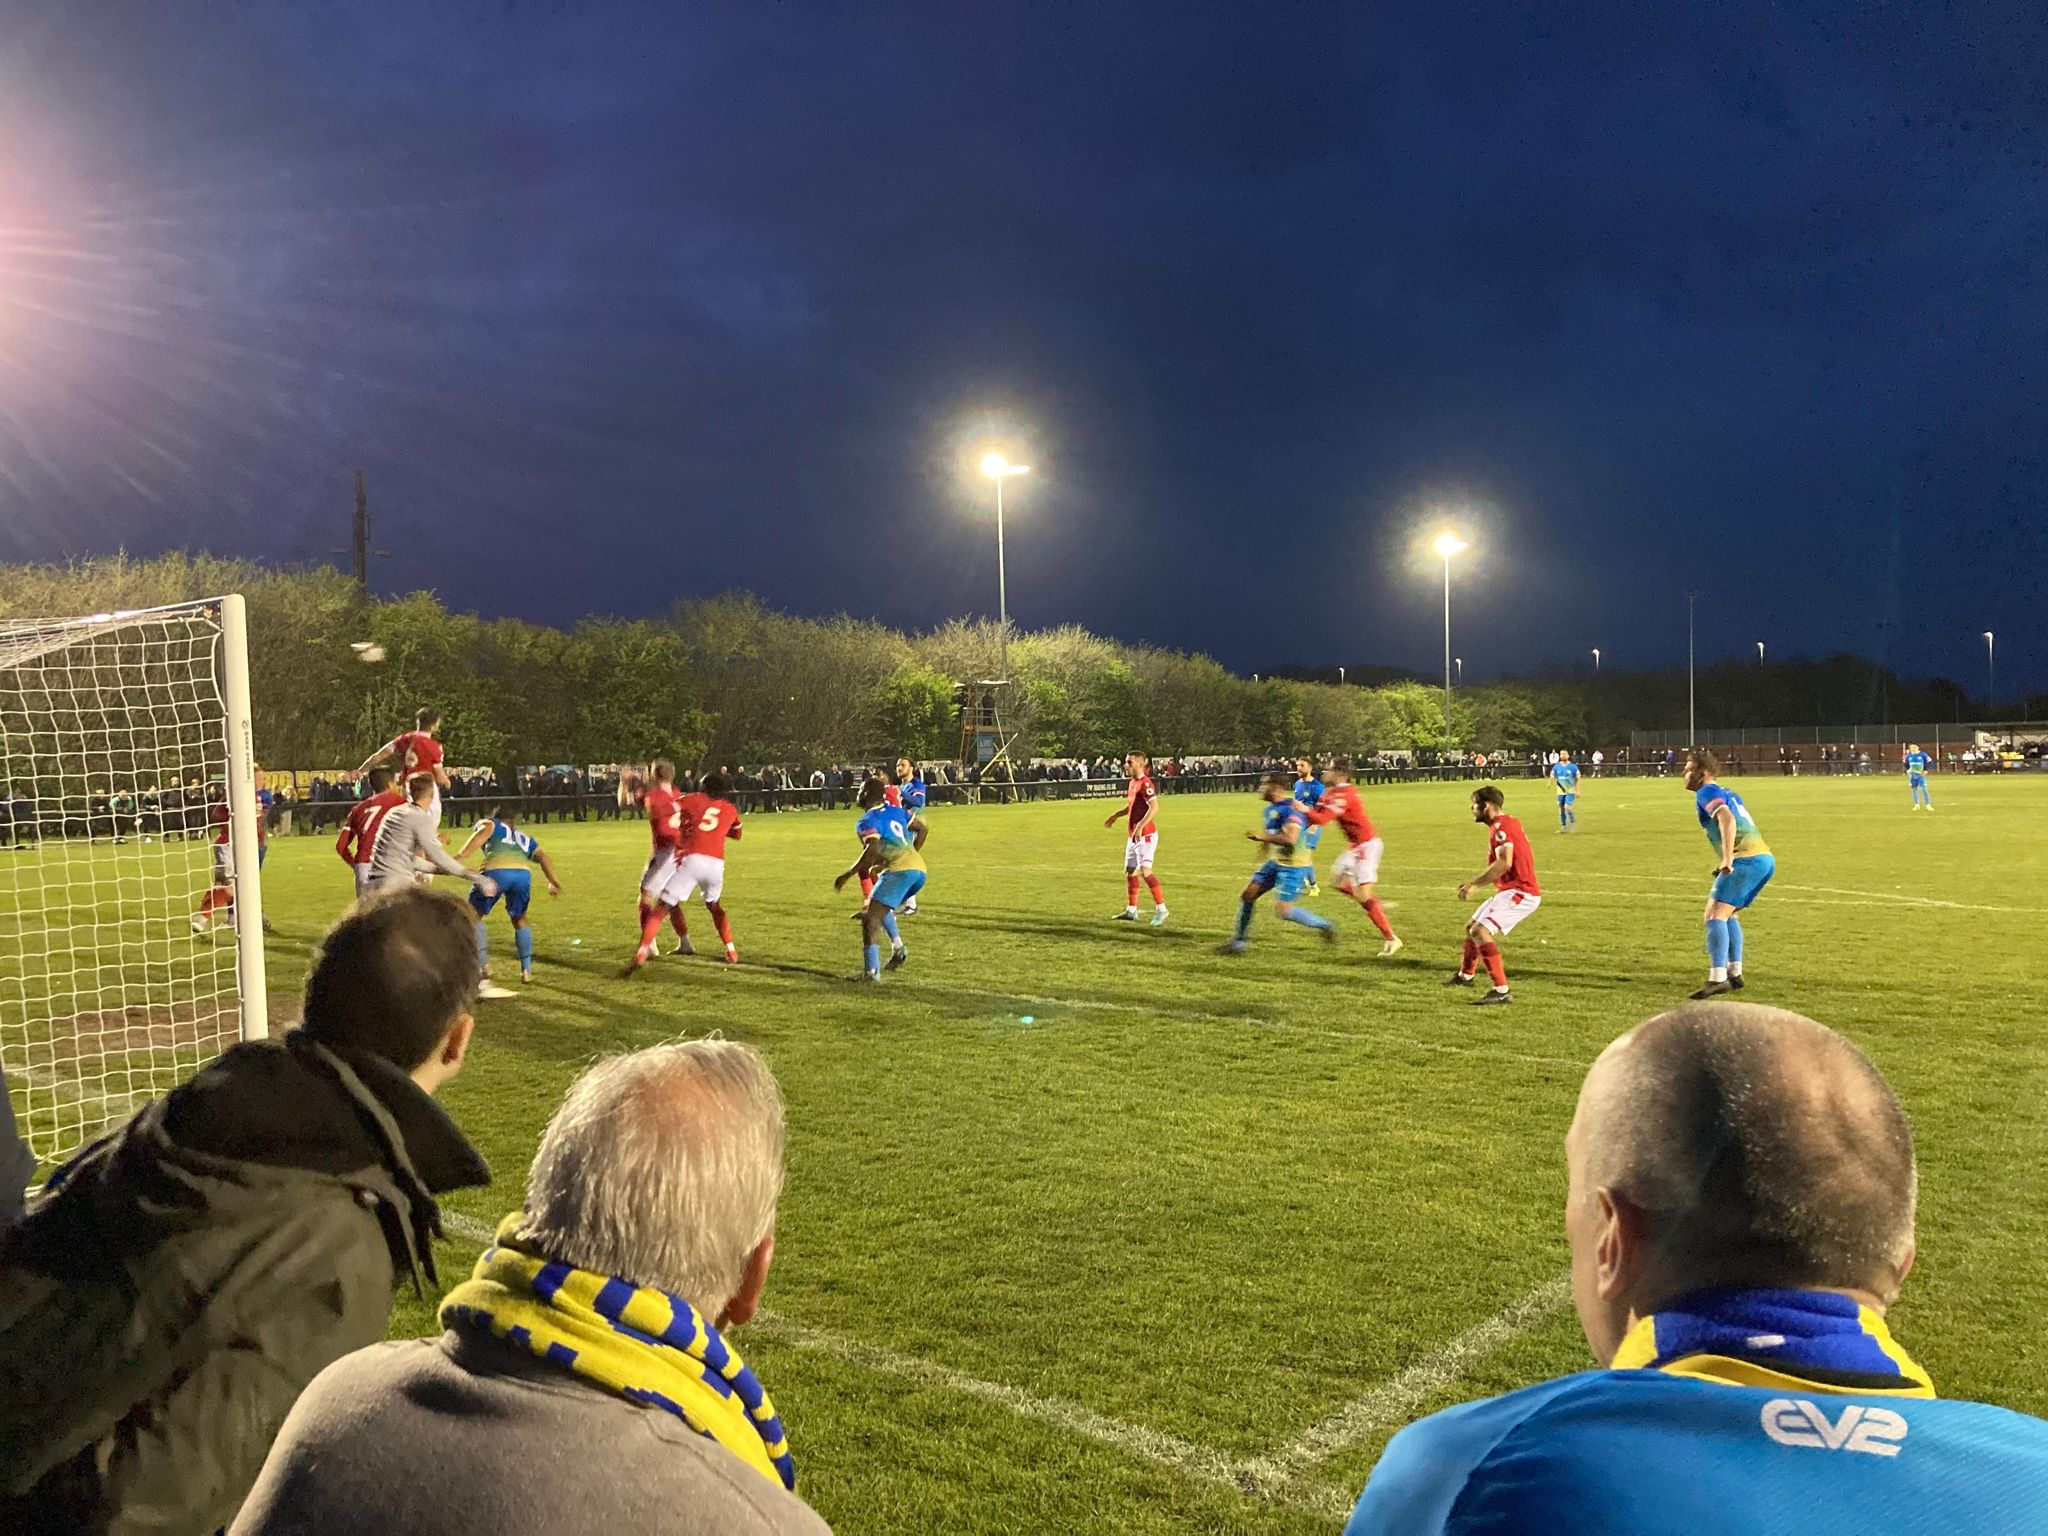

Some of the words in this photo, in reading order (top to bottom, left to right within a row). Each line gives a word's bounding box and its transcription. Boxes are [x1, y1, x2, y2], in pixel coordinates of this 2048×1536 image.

[363, 805, 382, 834] 7
[698, 806, 721, 832] 5
[890, 820, 908, 846] 9
[500, 822, 531, 853] 10
[1761, 1399, 1908, 1457] EV2
